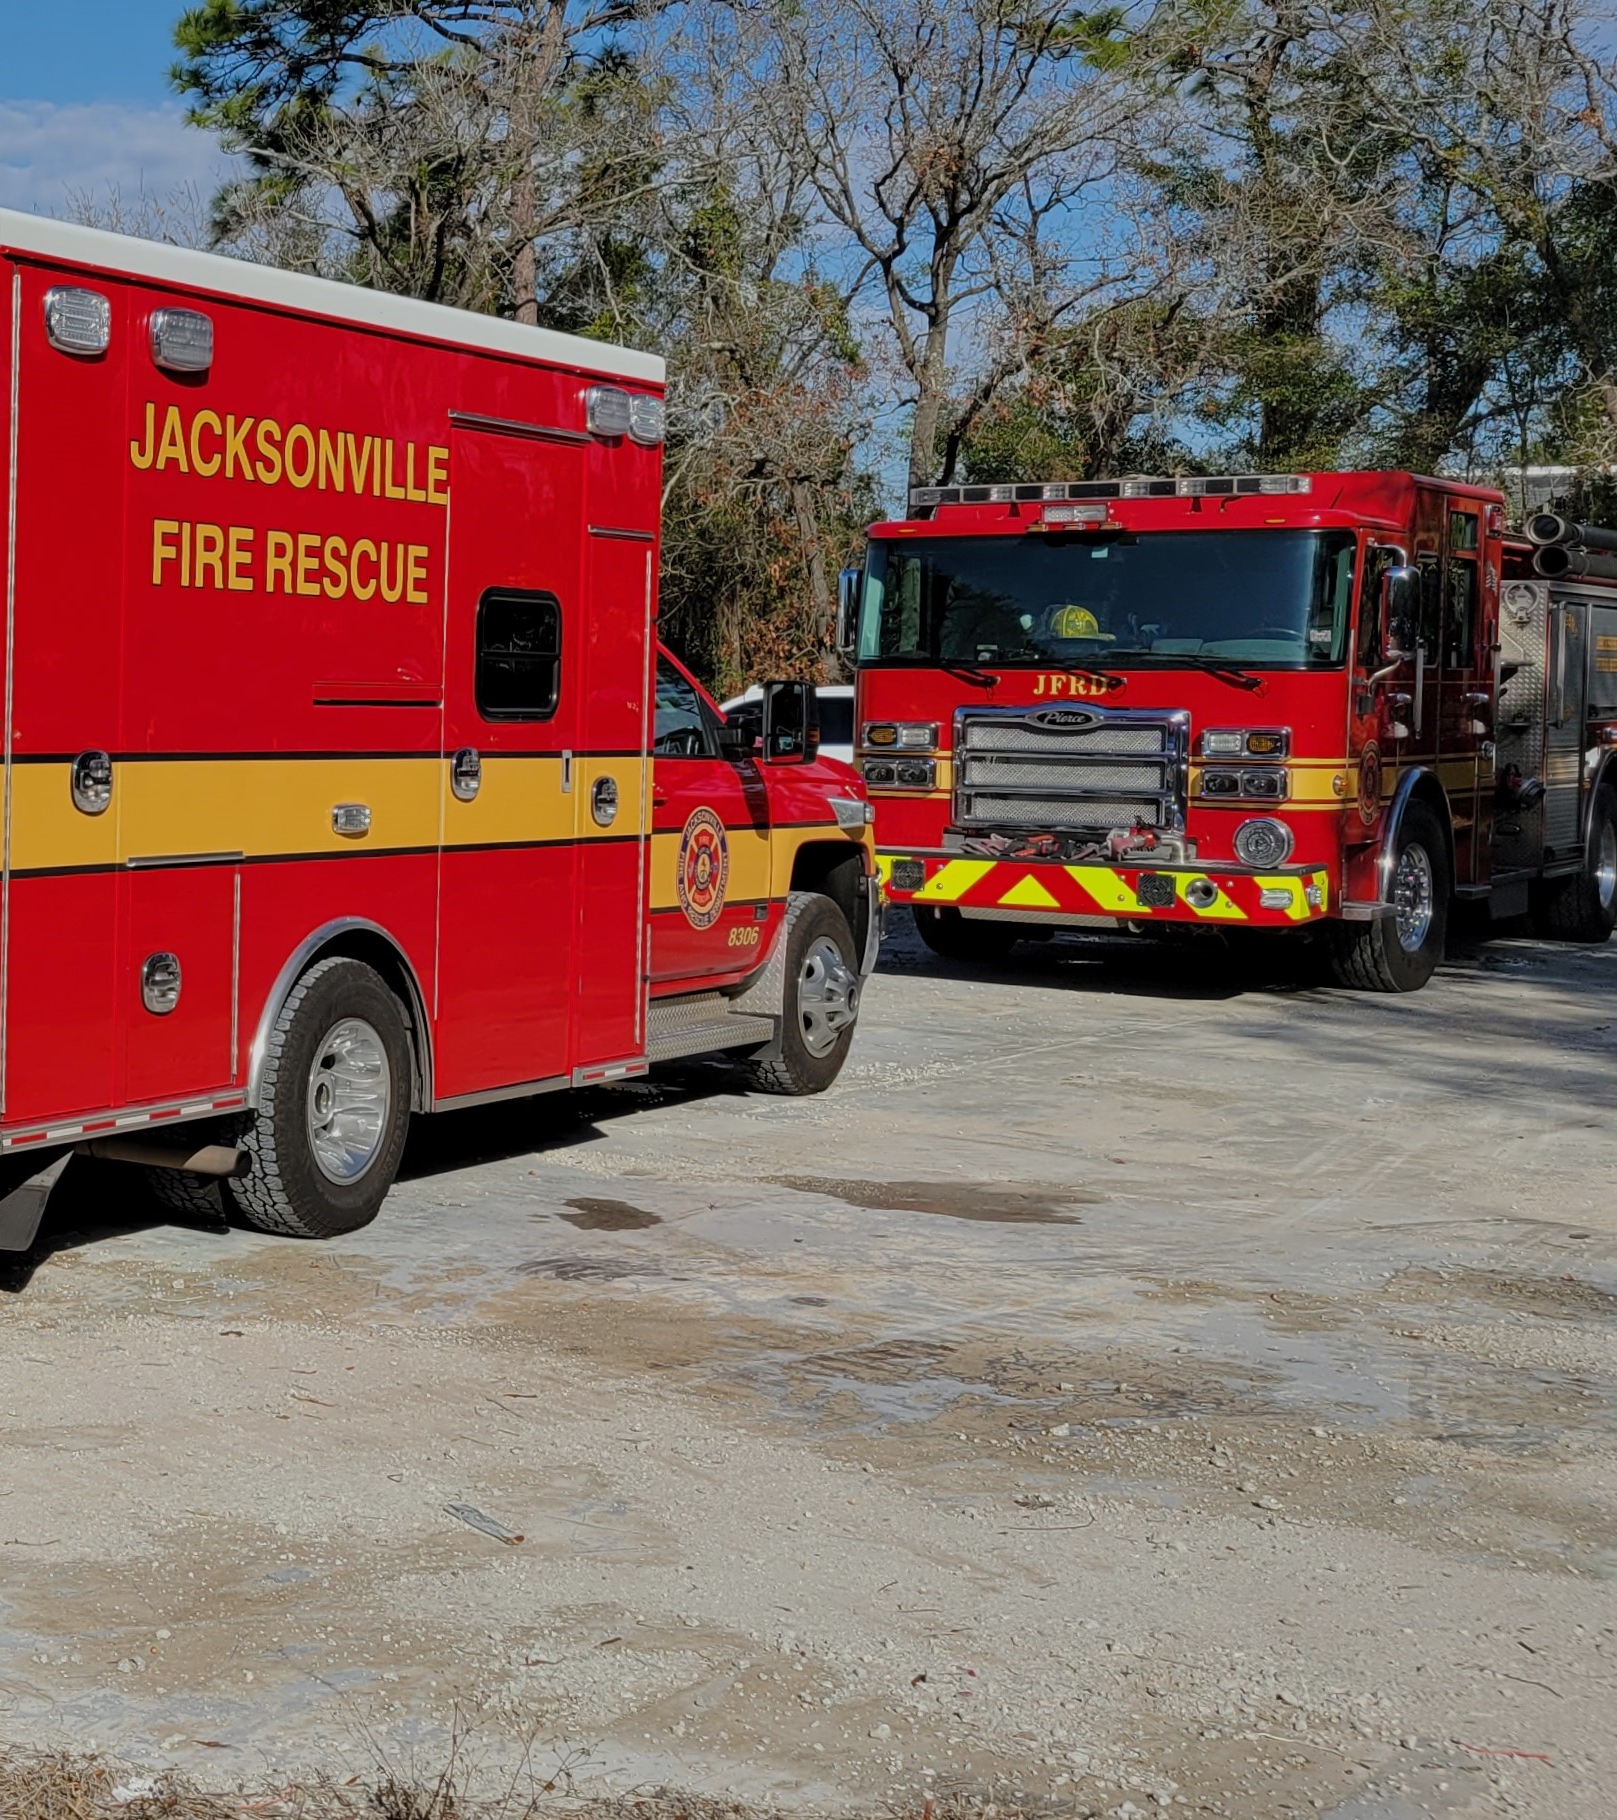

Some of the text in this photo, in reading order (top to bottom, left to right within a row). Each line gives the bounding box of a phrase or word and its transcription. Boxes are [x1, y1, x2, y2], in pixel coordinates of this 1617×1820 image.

[129, 401, 450, 506] JACKSONVILLE
[152, 518, 429, 605] FIRE RESCUE
[1033, 674, 1107, 696] JFRD
[1042, 711, 1086, 724] Pierce
[686, 810, 724, 841] JACKSONVILLE
[678, 883, 688, 908] AND
[728, 926, 760, 947] 8306
